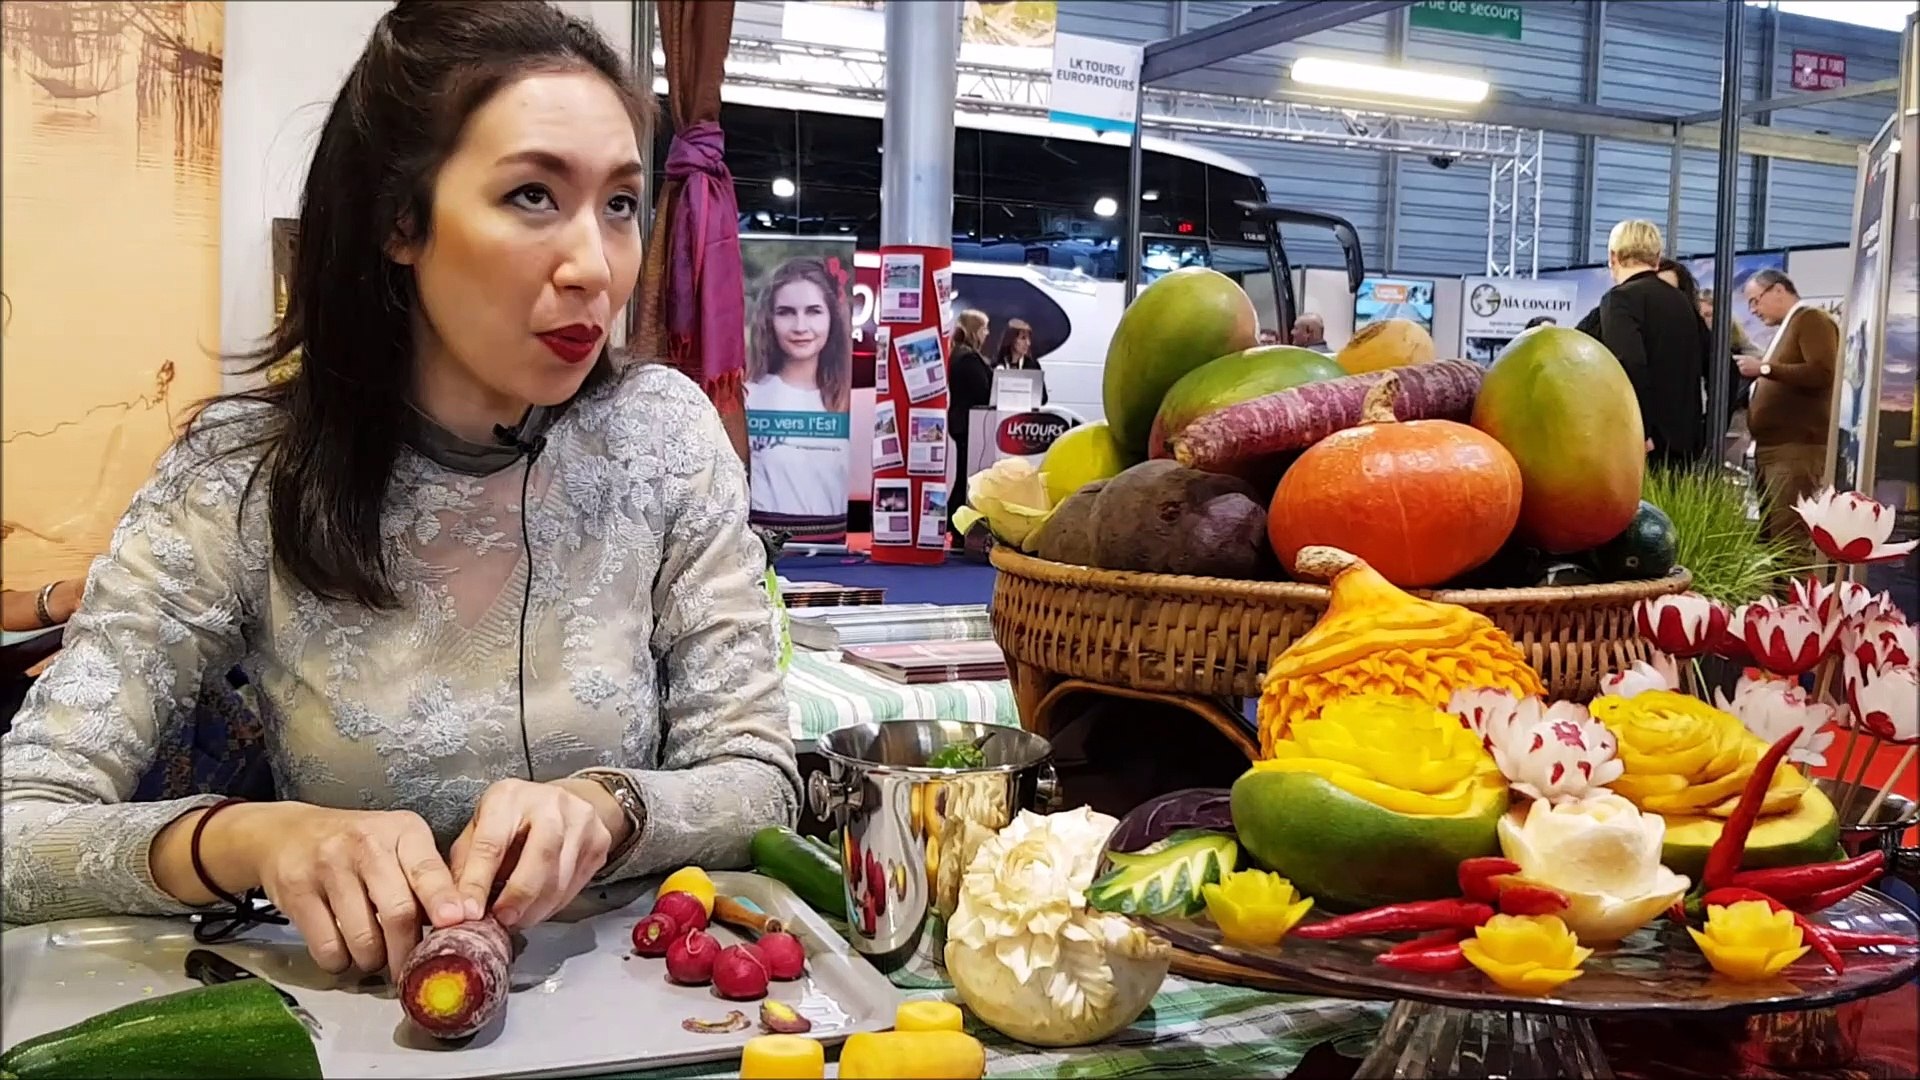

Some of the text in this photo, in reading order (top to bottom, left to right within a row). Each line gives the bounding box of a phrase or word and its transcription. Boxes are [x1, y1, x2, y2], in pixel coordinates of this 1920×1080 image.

[1449, 0, 1466, 13] de
[1470, 2, 1519, 20] secours
[1069, 57, 1126, 76] LK TOURS/
[1056, 69, 1135, 91] EUROPATOURS
[1522, 299, 1571, 311] CONCEPT
[746, 416, 837, 431] ap vers l'Est
